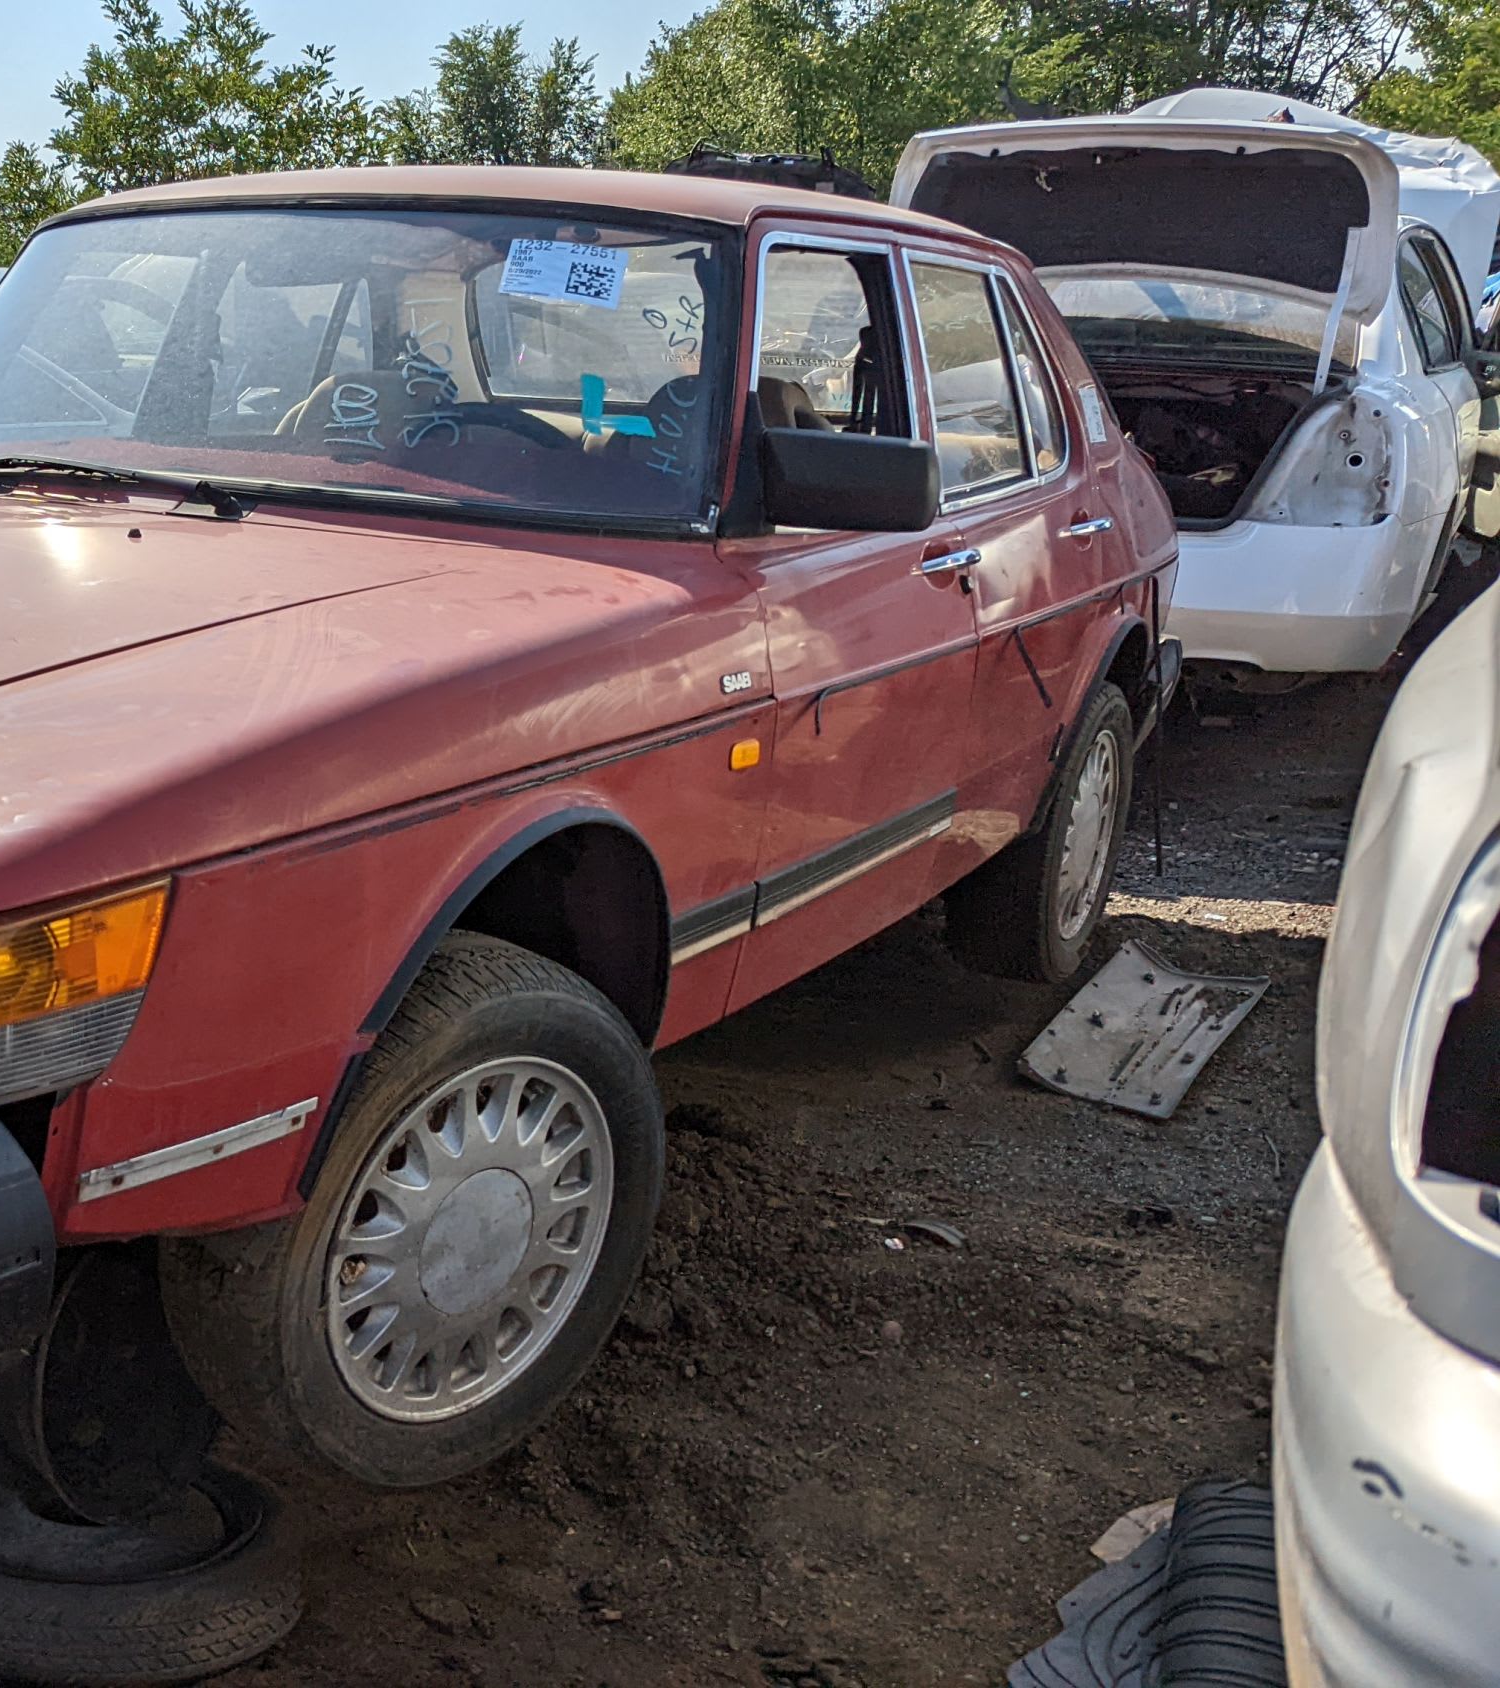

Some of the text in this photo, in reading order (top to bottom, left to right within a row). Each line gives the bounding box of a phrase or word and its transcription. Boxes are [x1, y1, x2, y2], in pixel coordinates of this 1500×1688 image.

[517, 240, 553, 252] 1232
[570, 243, 617, 260] 27551
[721, 671, 752, 693] SAAB
